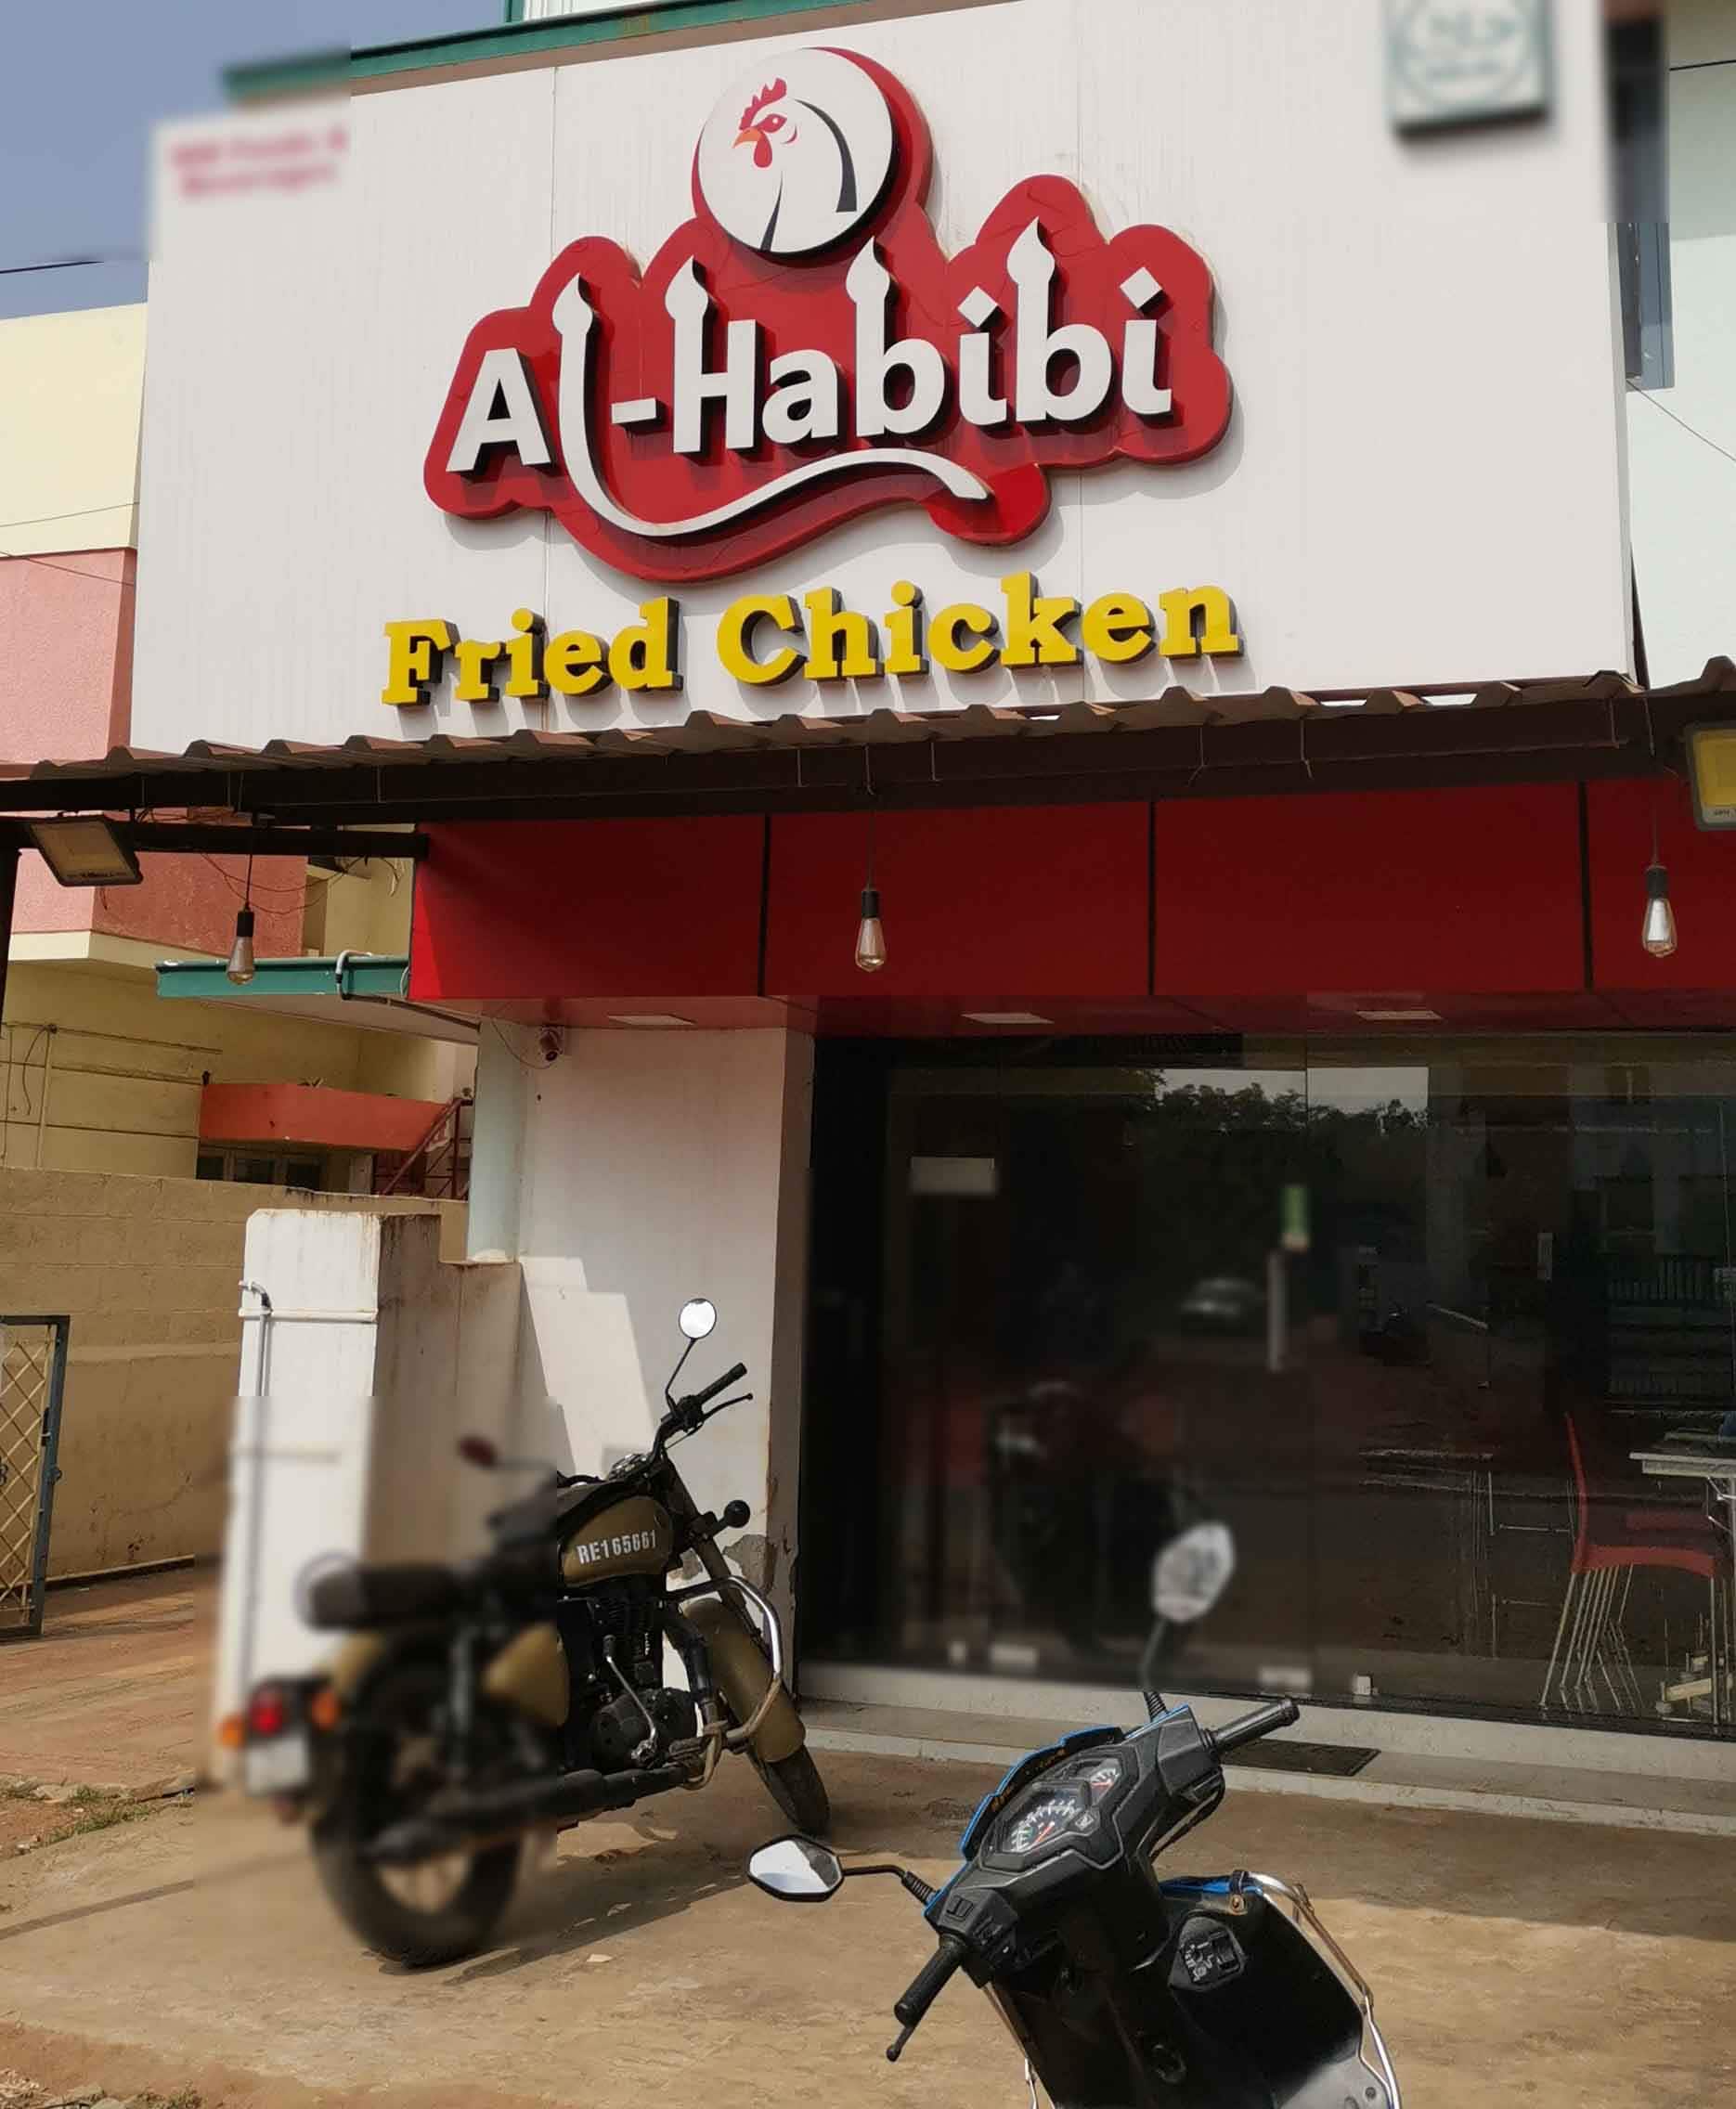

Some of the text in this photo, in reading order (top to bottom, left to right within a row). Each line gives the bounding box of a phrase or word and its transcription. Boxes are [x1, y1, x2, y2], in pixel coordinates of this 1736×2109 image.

[446, 217, 1173, 537] Al-Habibi
[382, 572, 1242, 705] Fried Chicken
